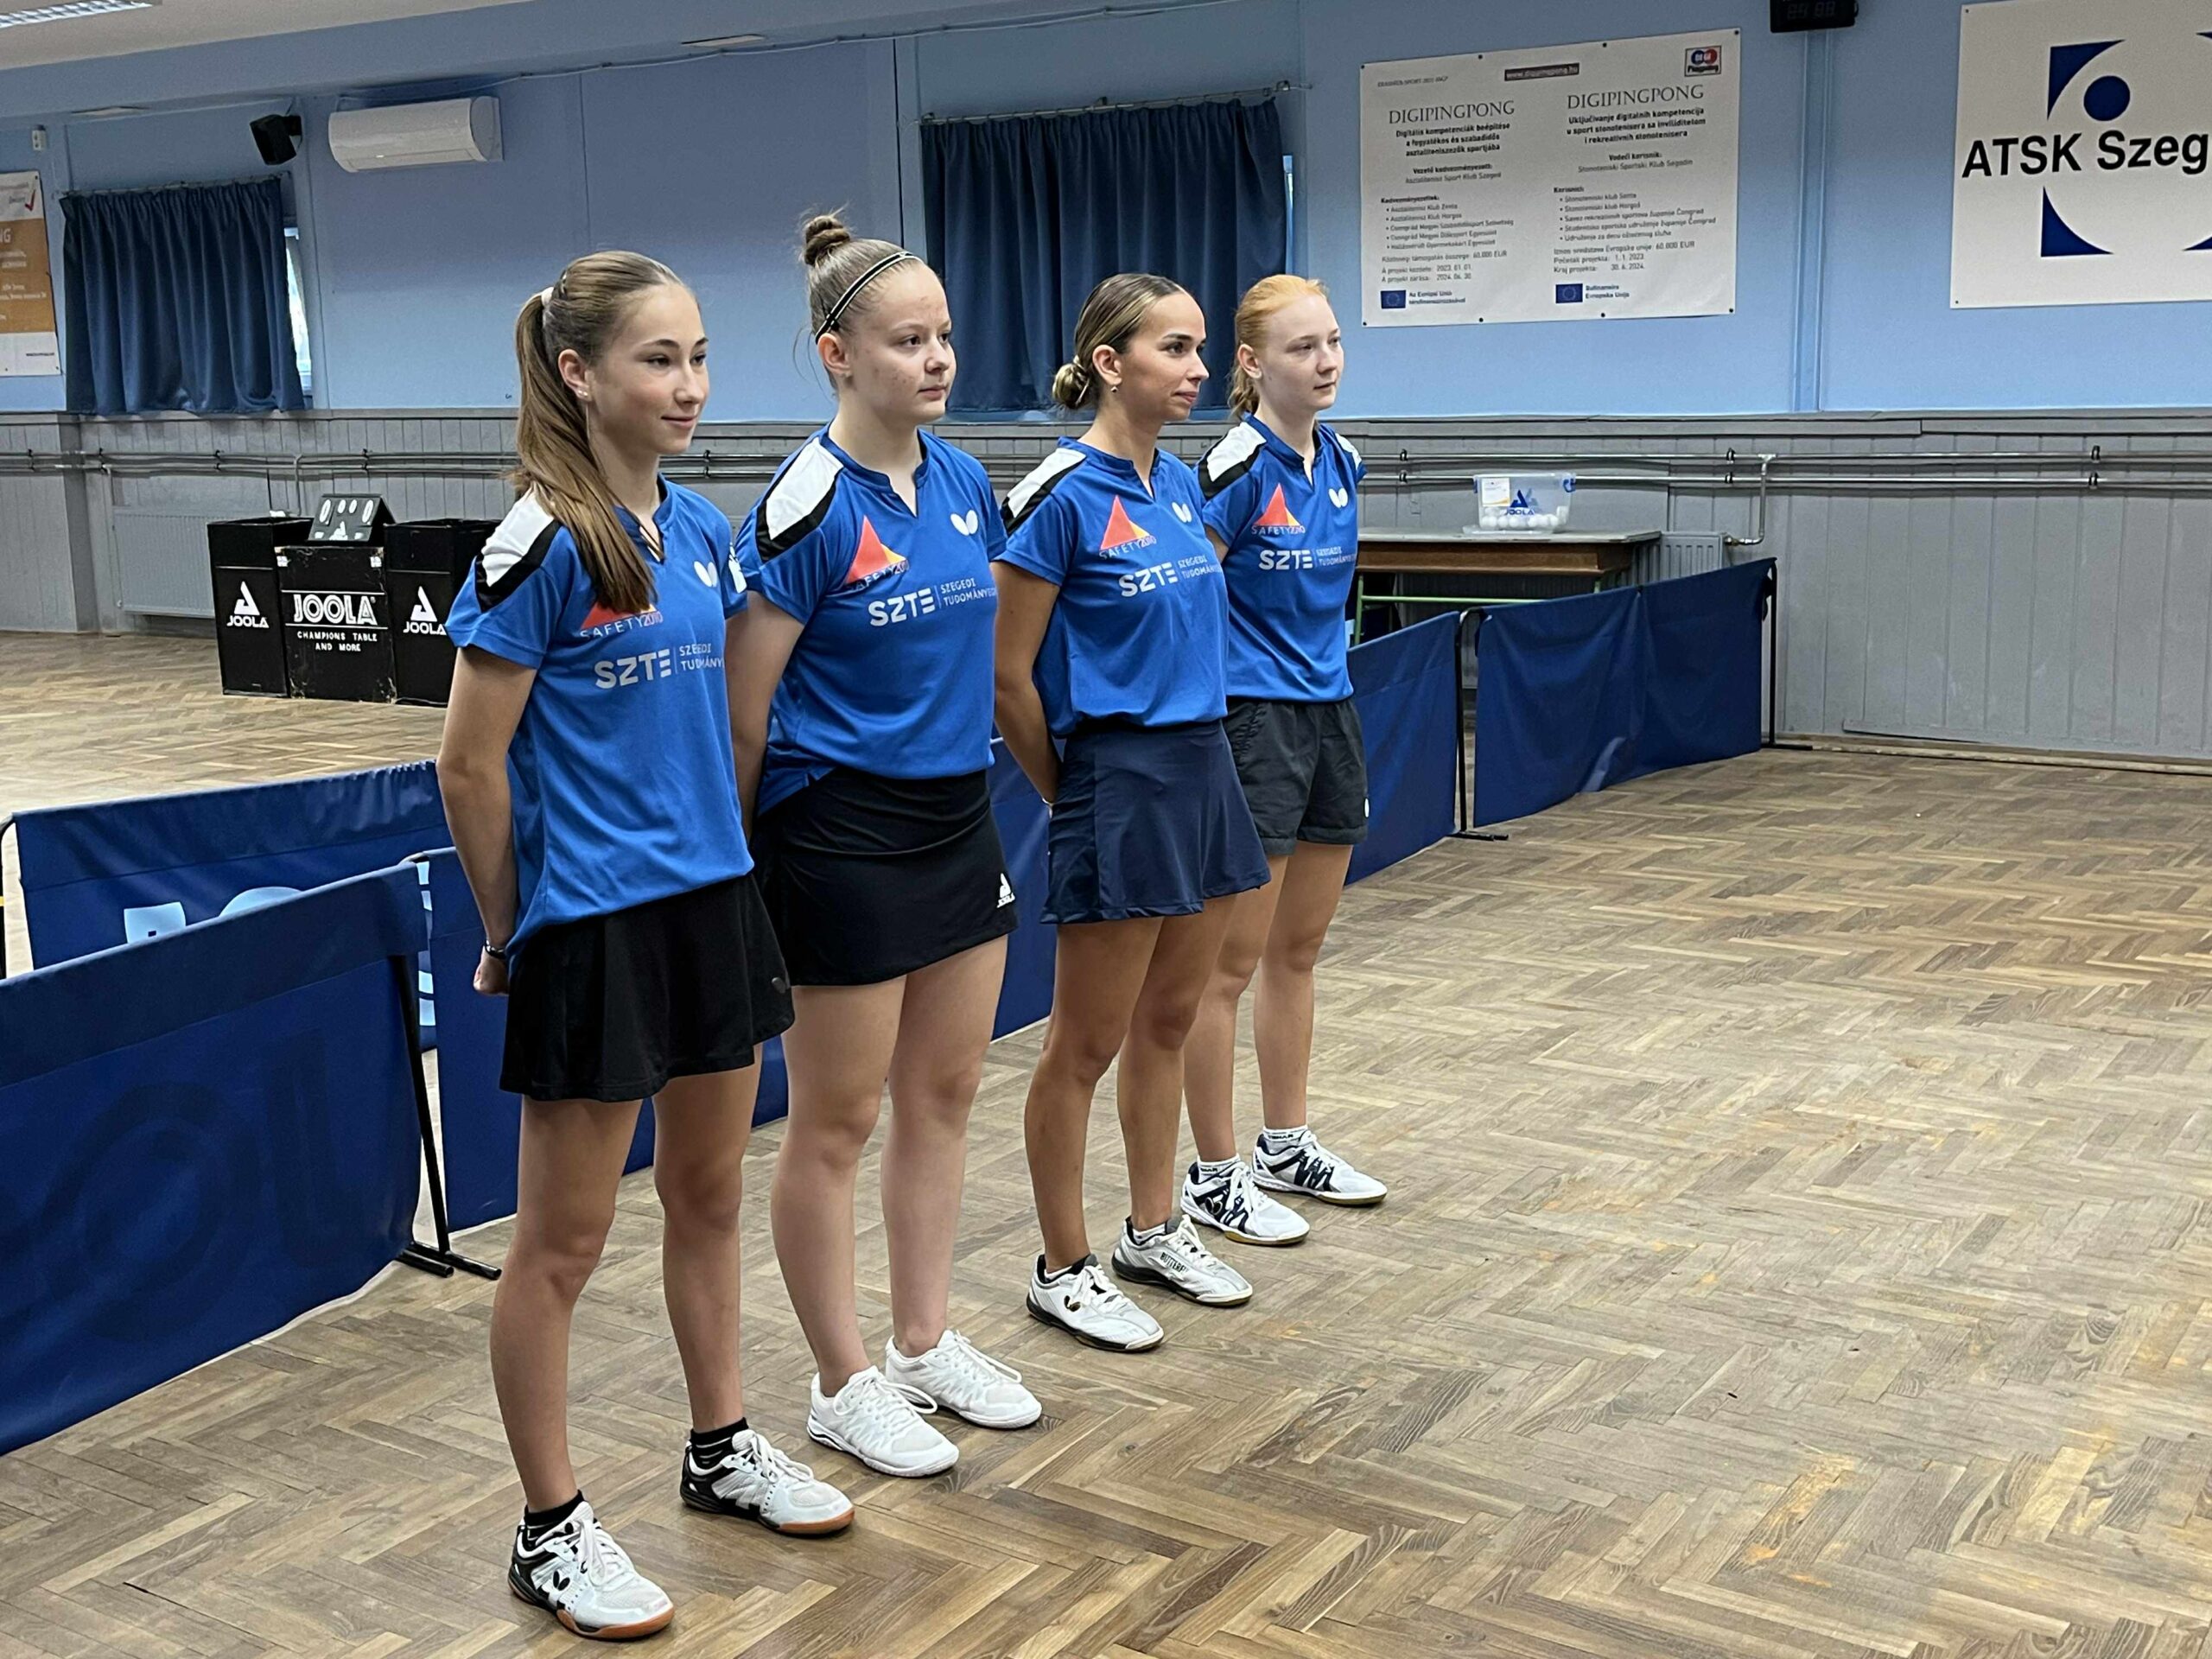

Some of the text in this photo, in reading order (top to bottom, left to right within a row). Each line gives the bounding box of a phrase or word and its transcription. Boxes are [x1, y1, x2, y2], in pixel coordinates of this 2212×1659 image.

[1567, 85, 1703, 110] DIGIPINGPONG
[1389, 100, 1514, 124] DIGIPINGPONG
[1652, 107, 1704, 119] kompetencija
[1573, 127, 1593, 136] sport
[1961, 130, 2209, 178] ATSK Szeg
[1258, 549, 1313, 570] SZTE
[940, 577, 976, 594] SZEGEDI
[1118, 562, 1178, 597] SZTE
[293, 594, 378, 626] JOOLA
[868, 588, 936, 626] SZTE
[226, 614, 269, 628] JOOLA
[403, 620, 447, 636] JOOLA
[296, 630, 378, 642] CHAMPIONS TABLE
[315, 642, 361, 652] AND MORE
[594, 648, 671, 690] SZTE
[1160, 1251, 1190, 1273] BUTTERF
